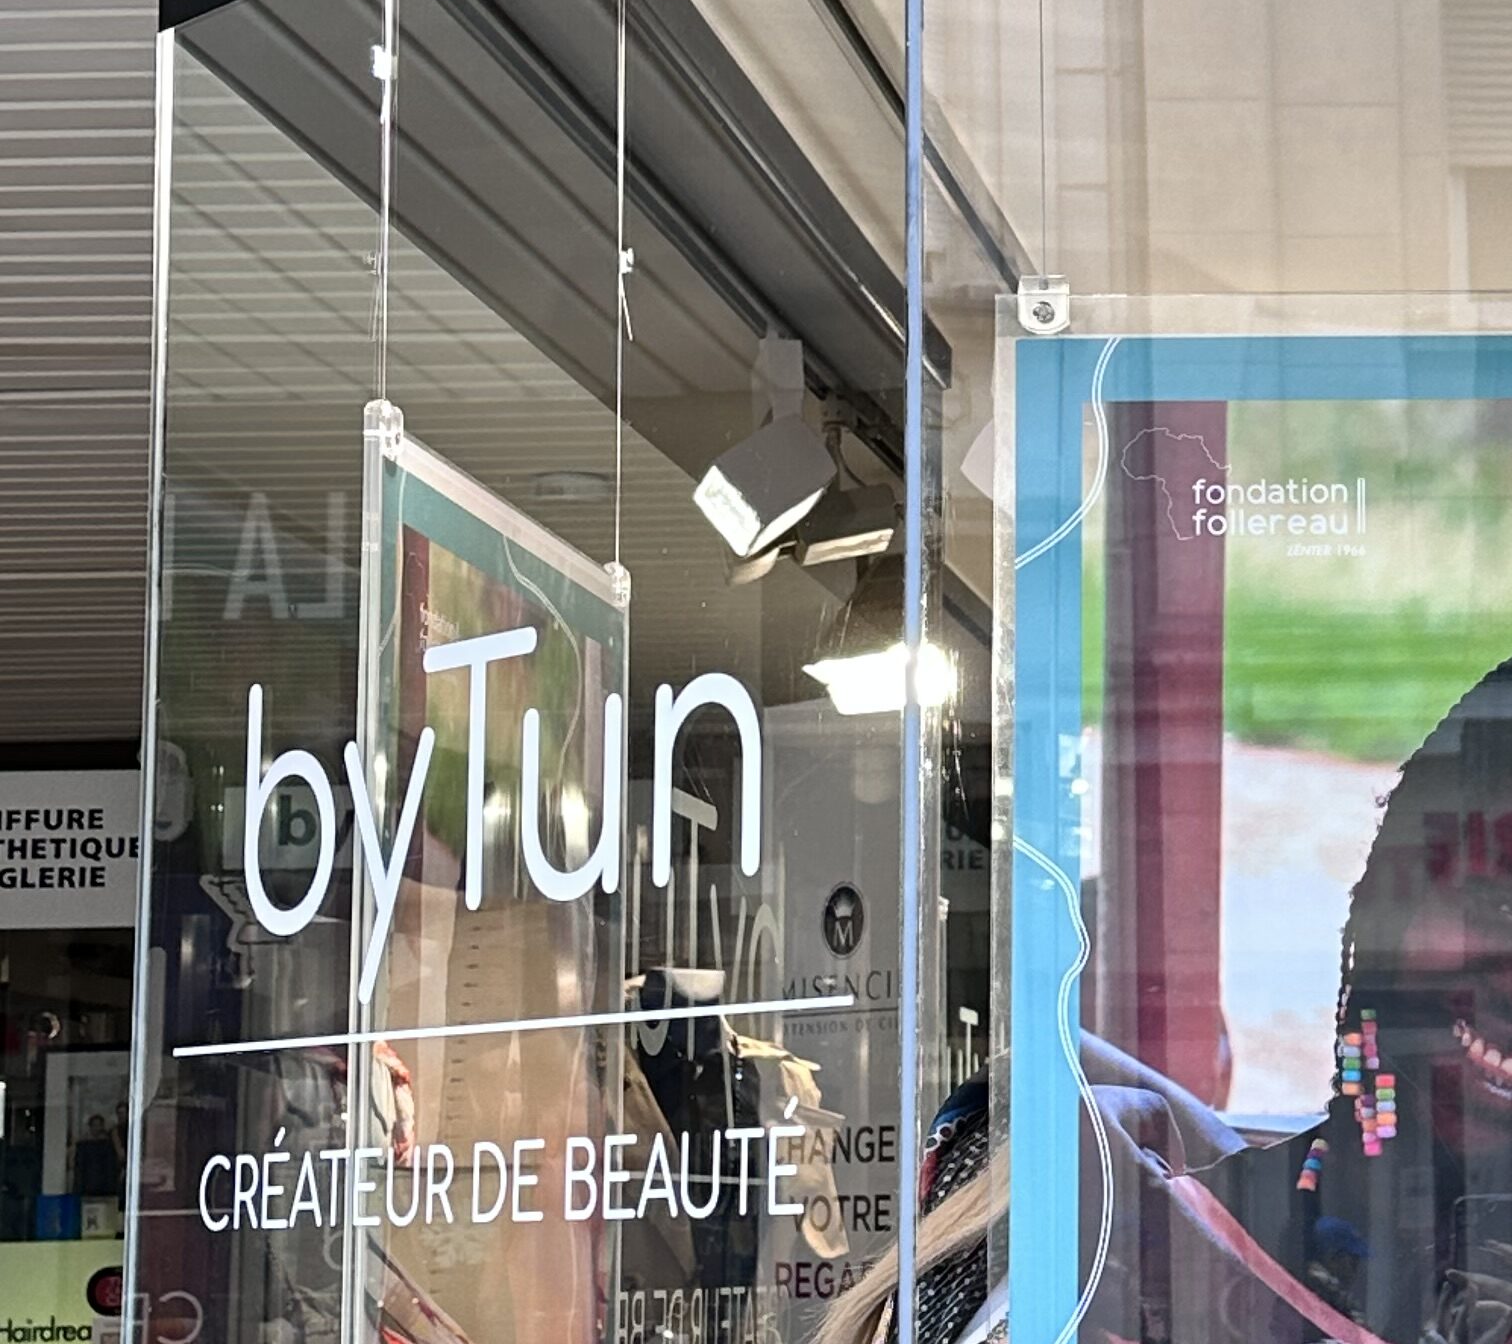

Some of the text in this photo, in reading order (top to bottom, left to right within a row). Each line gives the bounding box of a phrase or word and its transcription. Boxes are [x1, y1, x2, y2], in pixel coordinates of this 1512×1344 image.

[1191, 478, 1348, 504] fondation
[1191, 509, 1348, 536] follereau
[244, 626, 761, 1006] byTun
[199, 1095, 807, 1233] CRÉATEUR DE BEAUTÉ
[780, 1125, 896, 1167] HANGE
[774, 1262, 876, 1301] REGA
